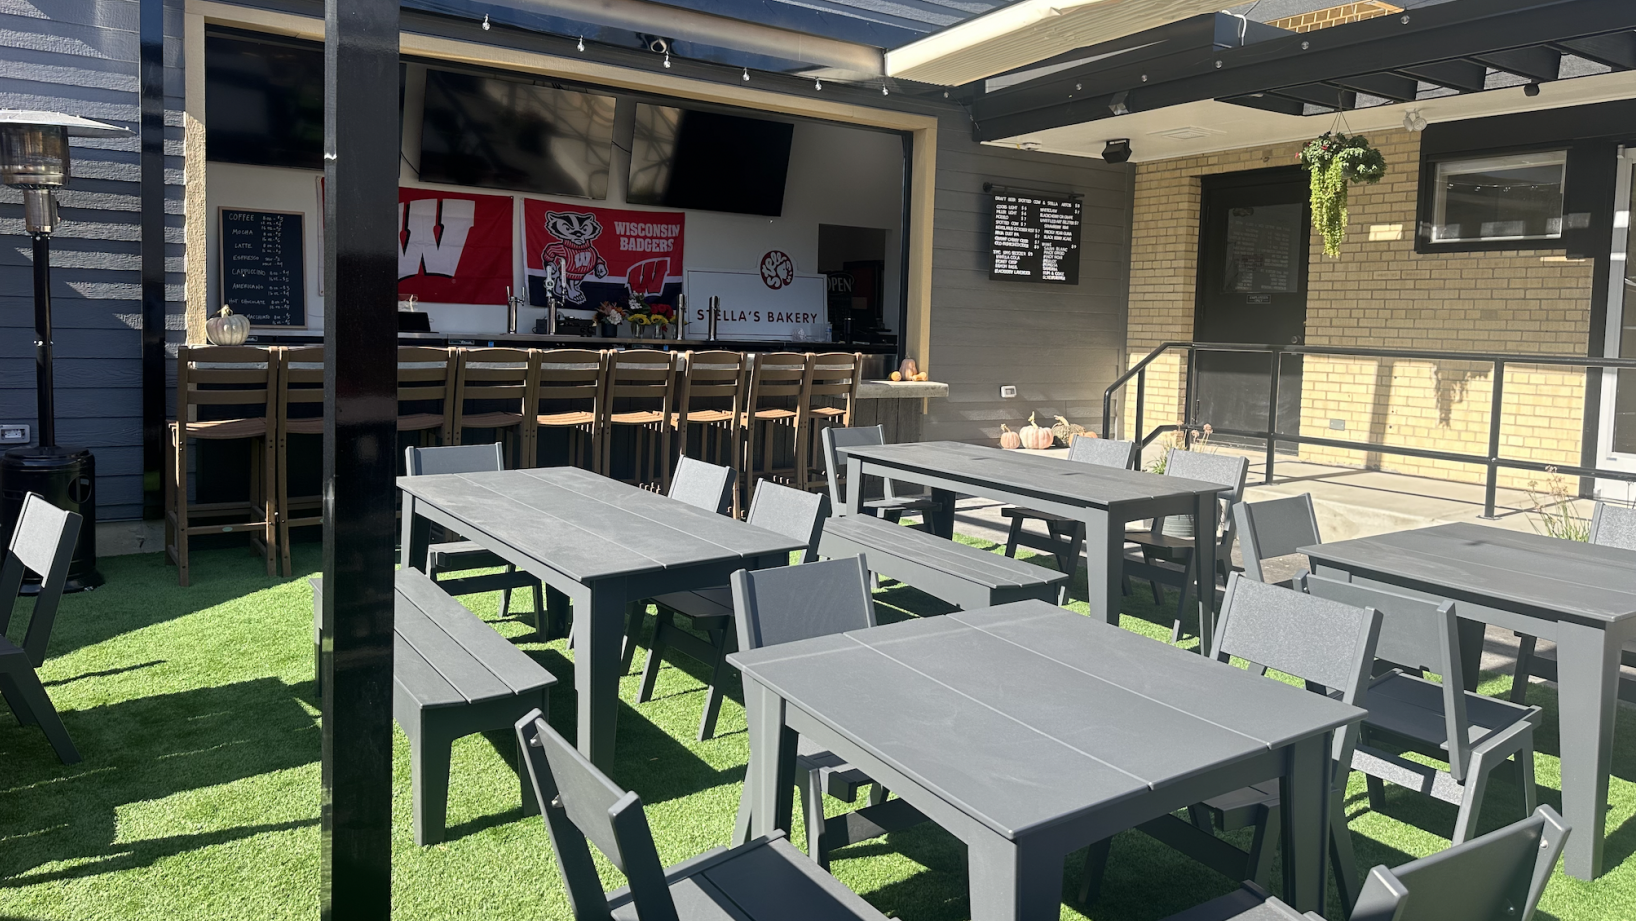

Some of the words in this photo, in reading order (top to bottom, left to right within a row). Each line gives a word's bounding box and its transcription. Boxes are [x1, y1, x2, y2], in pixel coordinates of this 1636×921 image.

[229, 213, 255, 221] COFFEE
[614, 221, 680, 237] WISCONSIN
[398, 198, 475, 278] W
[619, 238, 674, 252] BADGERS
[574, 251, 592, 268] W
[232, 268, 266, 276] CAPPUCCINO
[627, 258, 669, 296] W
[767, 312, 818, 324] BAKERY
